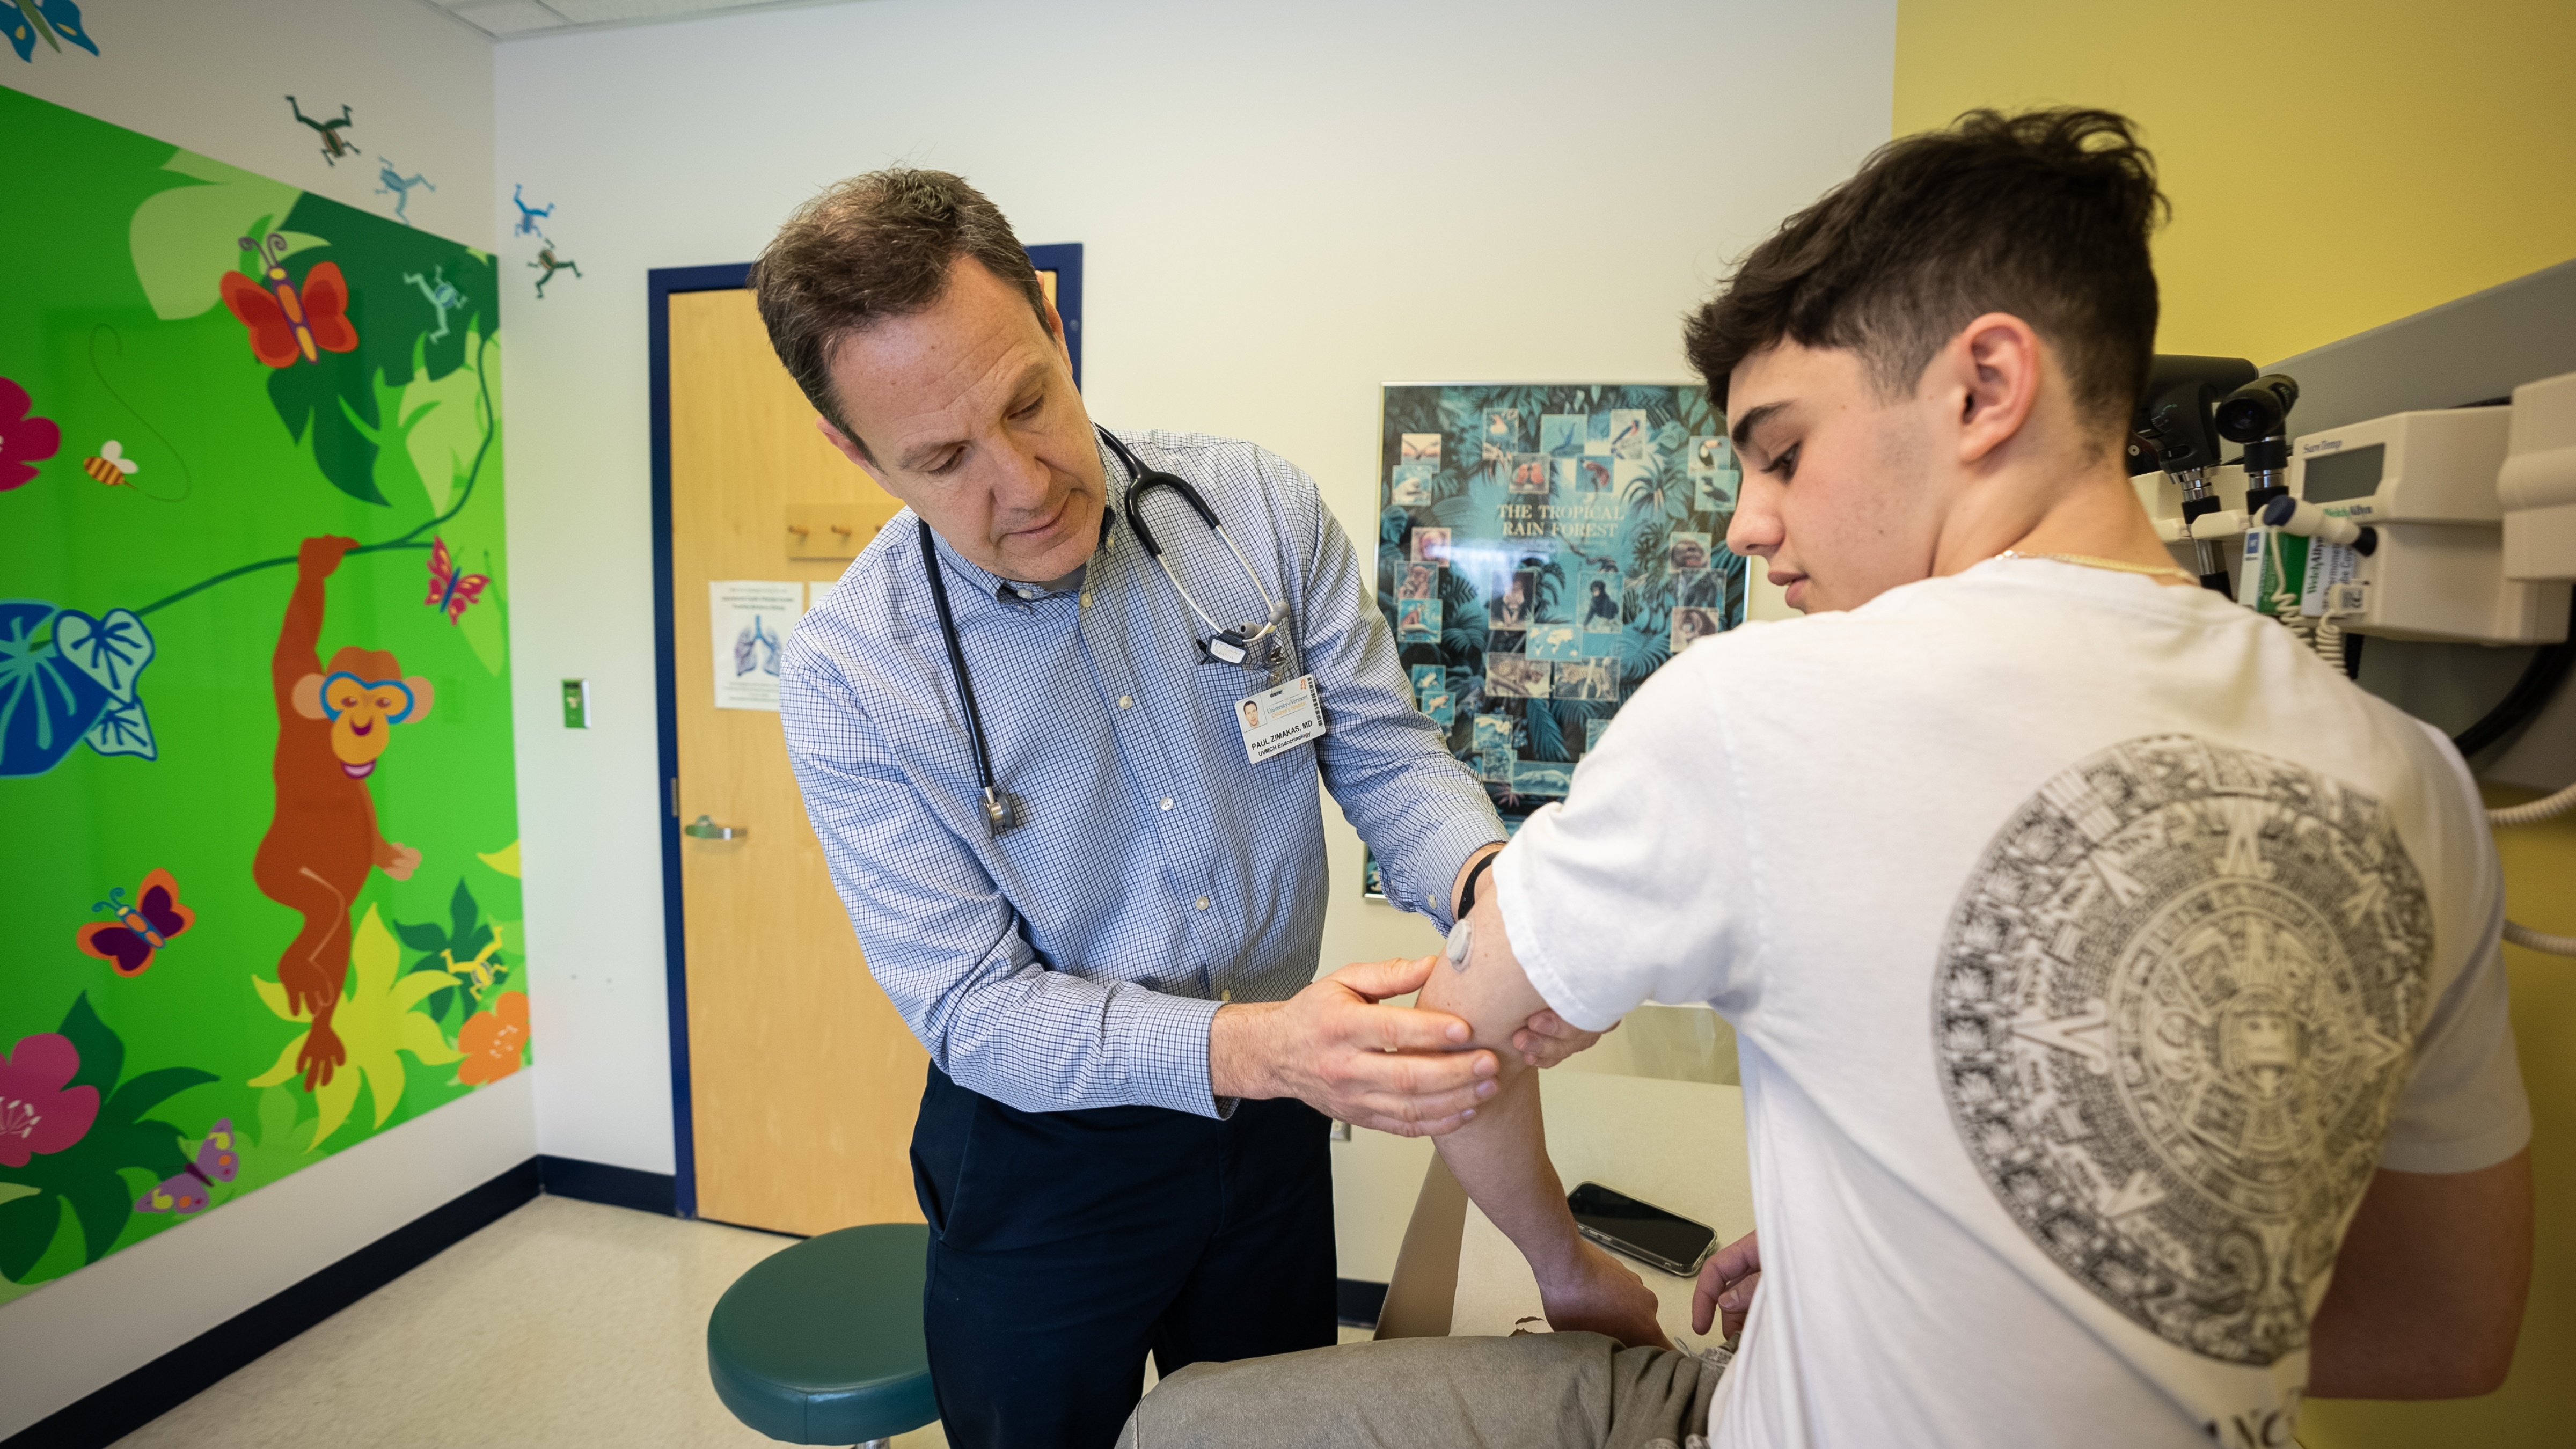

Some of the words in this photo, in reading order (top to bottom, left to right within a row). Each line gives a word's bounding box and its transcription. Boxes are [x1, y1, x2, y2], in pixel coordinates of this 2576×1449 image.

[1496, 504, 1532, 519] THE
[1538, 504, 1624, 521] TROPICAL
[1503, 521, 1545, 536] RAIN
[1551, 522, 1619, 537] FOREST
[1267, 702, 1288, 714] University
[1290, 694, 1308, 704] Vermont
[1252, 738, 1270, 750] PAUL
[1270, 725, 1302, 743] ZIMAKAS,
[1302, 720, 1313, 729] MD
[1258, 744, 1277, 757] UVMCH
[1277, 731, 1311, 749] Endocrinology
